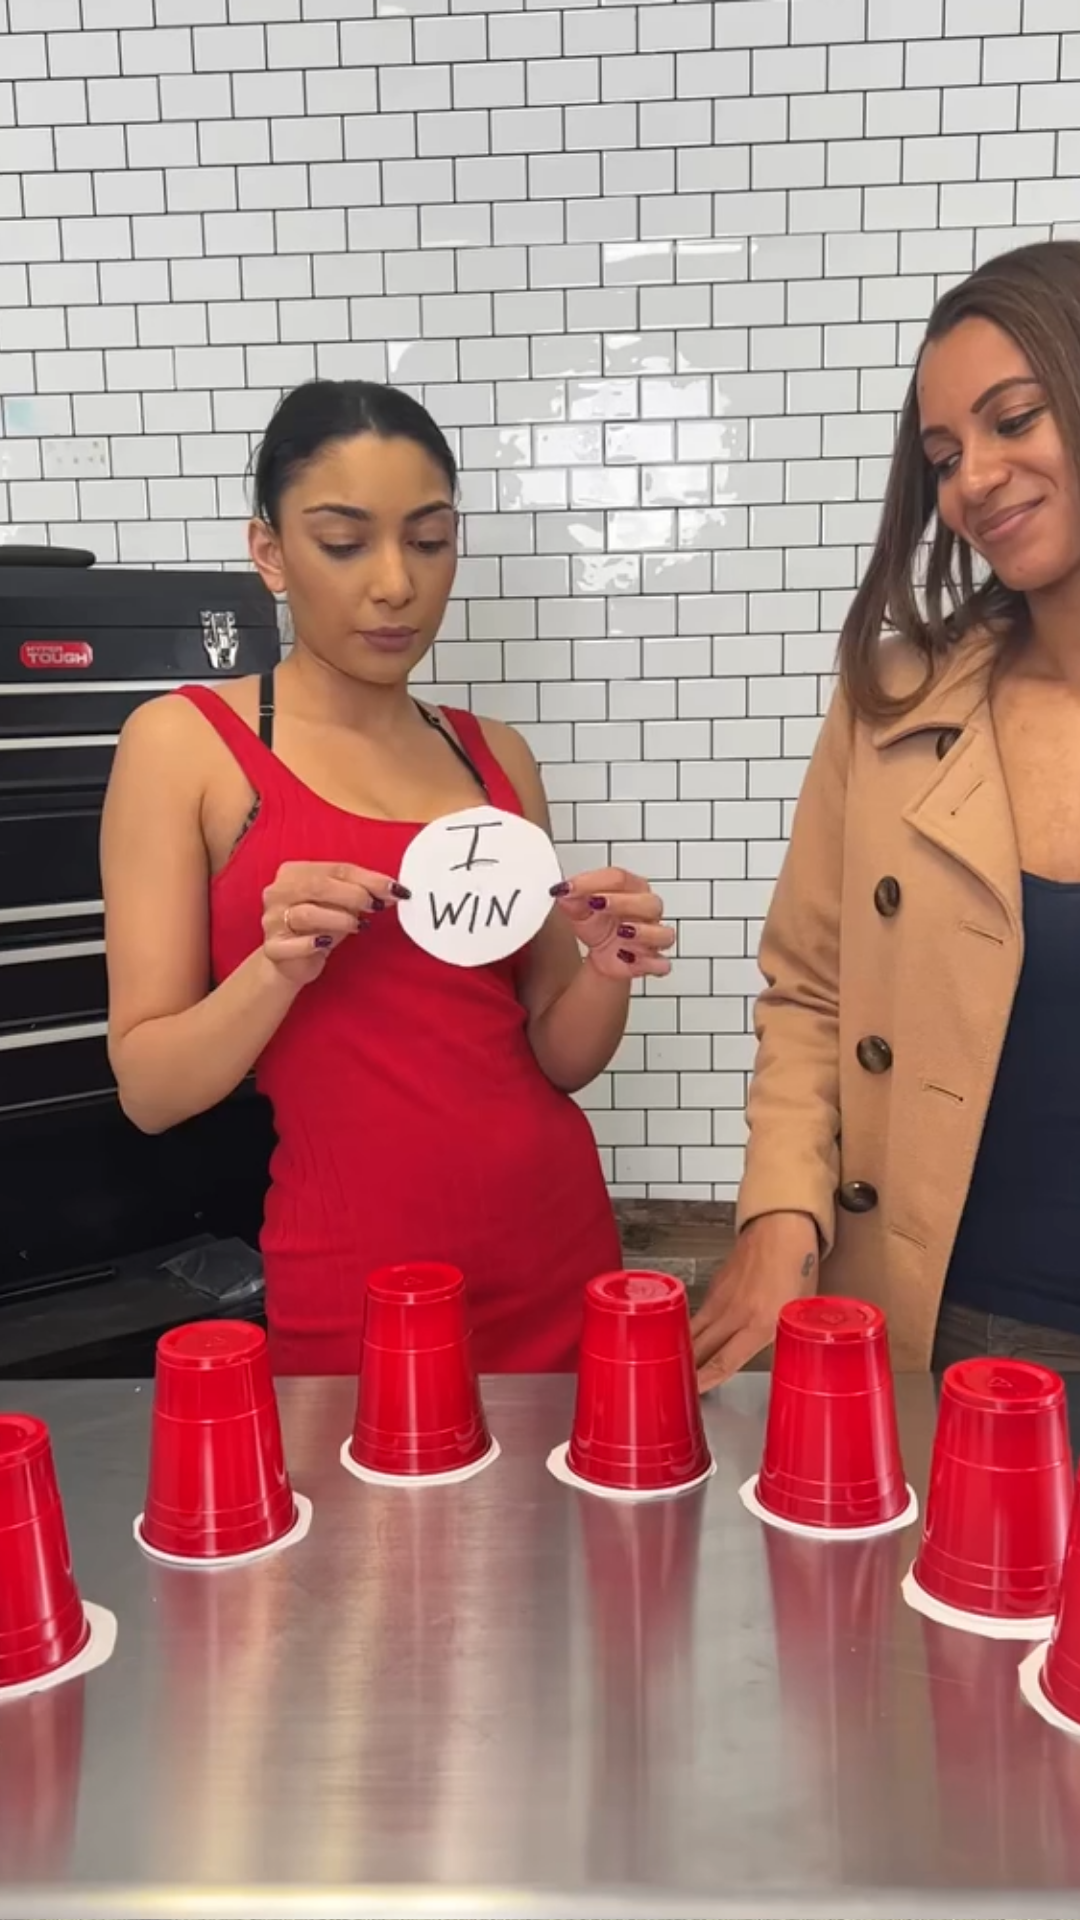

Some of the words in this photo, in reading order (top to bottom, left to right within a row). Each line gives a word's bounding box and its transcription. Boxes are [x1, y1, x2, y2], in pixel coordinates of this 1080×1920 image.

[27, 652, 88, 665] TOUGH
[446, 821, 502, 871] I
[429, 888, 521, 934] WIN
